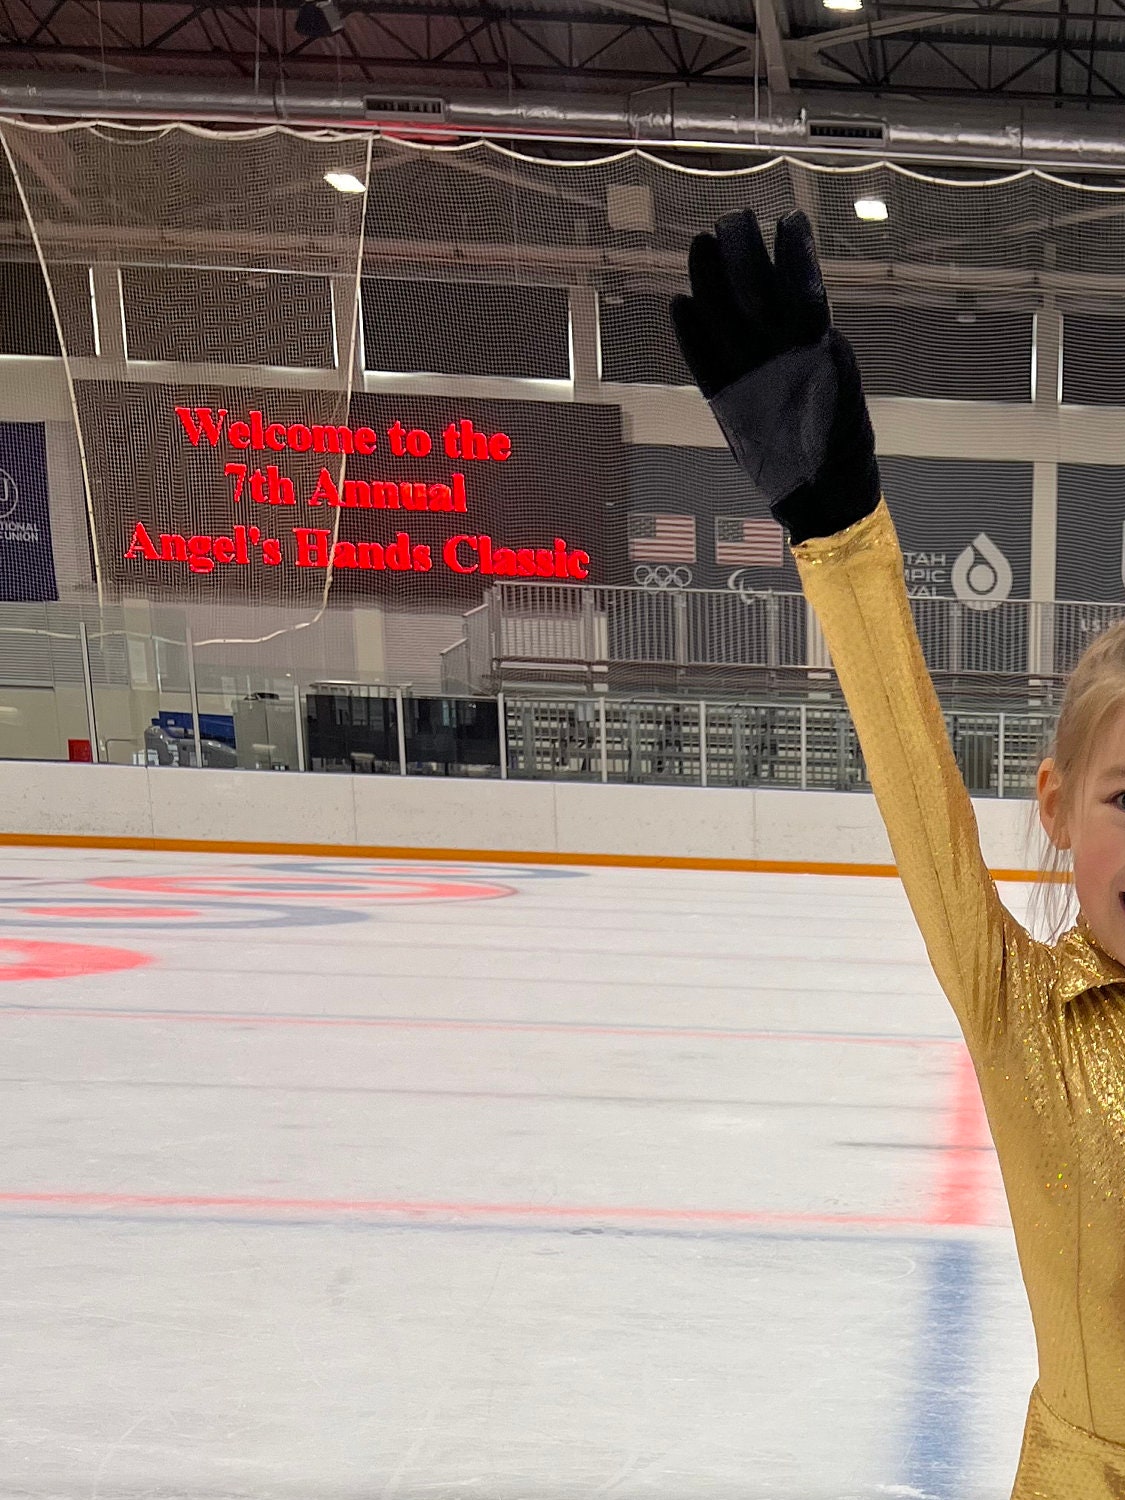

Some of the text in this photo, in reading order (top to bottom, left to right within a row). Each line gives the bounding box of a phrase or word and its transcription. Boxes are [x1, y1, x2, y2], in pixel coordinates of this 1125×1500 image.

[175, 406, 512, 461] Welcome to the
[225, 463, 468, 512] 7th Annual
[5, 531, 39, 542] UNION
[124, 521, 590, 579] Angel's Hands Classic
[903, 552, 946, 566] TAH
